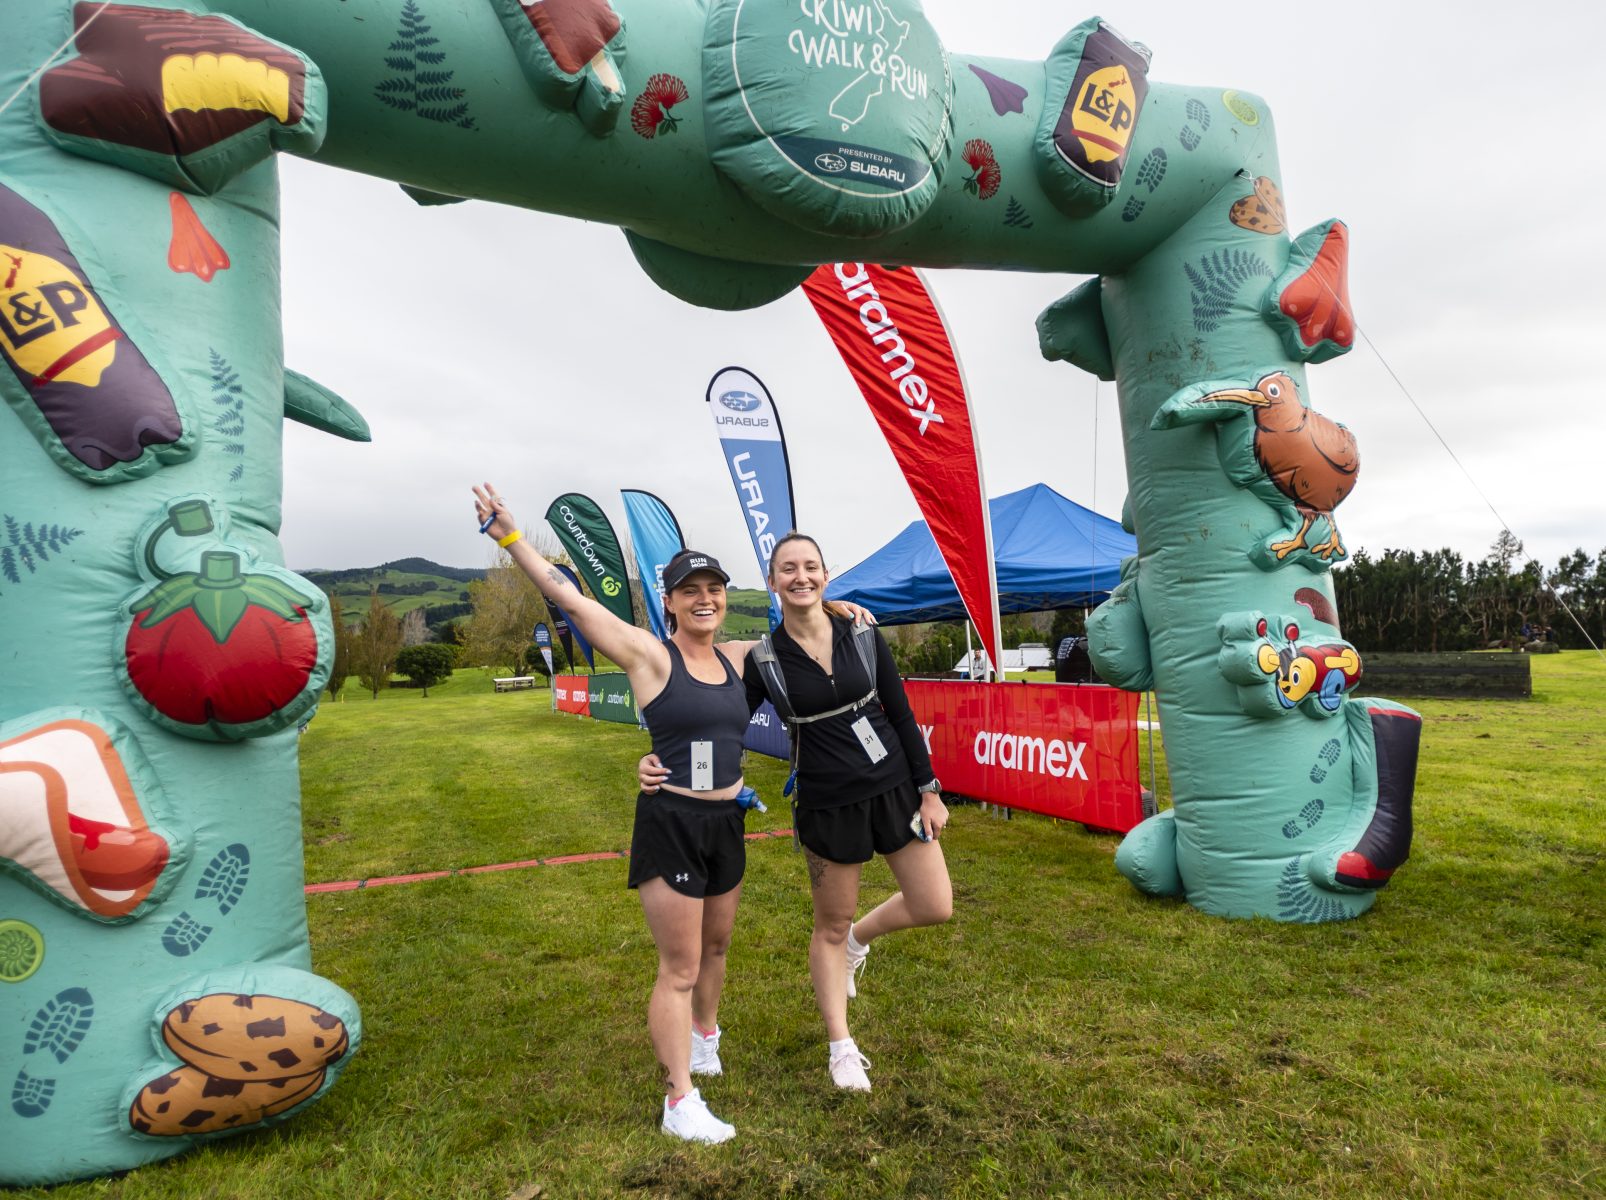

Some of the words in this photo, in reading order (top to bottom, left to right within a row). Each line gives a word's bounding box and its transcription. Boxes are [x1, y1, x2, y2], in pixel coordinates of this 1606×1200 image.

[801, 0, 873, 37] KIWI
[789, 29, 865, 69] WALK
[870, 43, 887, 76] &
[888, 54, 927, 100] RUN
[1079, 82, 1132, 132] L&P
[838, 147, 883, 163] PRESENTED
[883, 155, 893, 164] BY
[850, 161, 905, 183] SUBARU
[0, 281, 88, 350] L&P
[834, 262, 945, 436] aramex
[560, 505, 605, 577] countdown
[690, 557, 707, 565] RUN
[864, 735, 874, 745] 31
[974, 730, 1088, 781] aramex
[696, 761, 708, 770] 26
